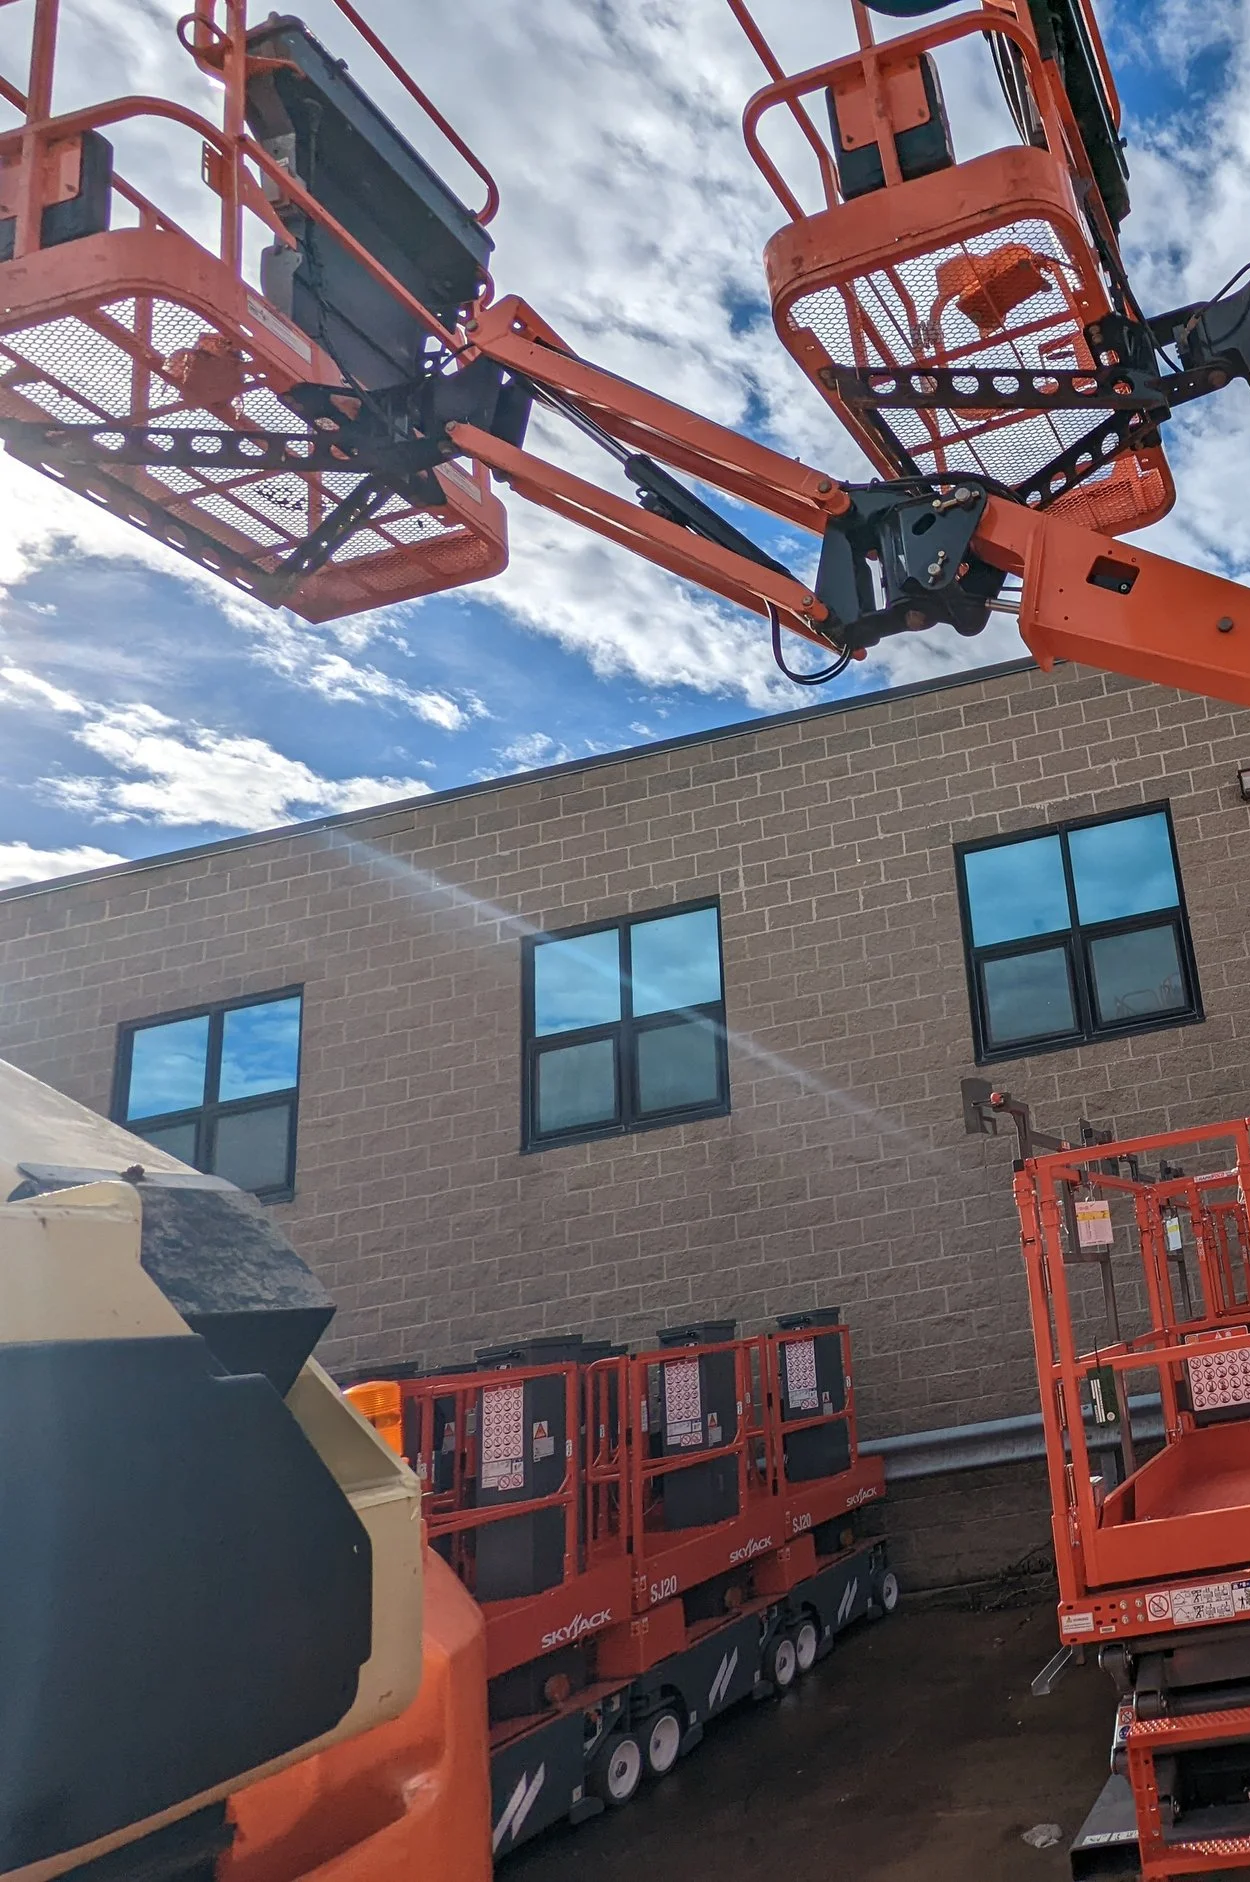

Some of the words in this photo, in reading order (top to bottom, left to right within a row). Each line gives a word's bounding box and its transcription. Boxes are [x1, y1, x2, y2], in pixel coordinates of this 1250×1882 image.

[792, 1513, 812, 1533] SJ20
[729, 1535, 773, 1563] SKYJACK
[650, 1575, 677, 1604] SJ20
[541, 1608, 612, 1649] SKYJACK
